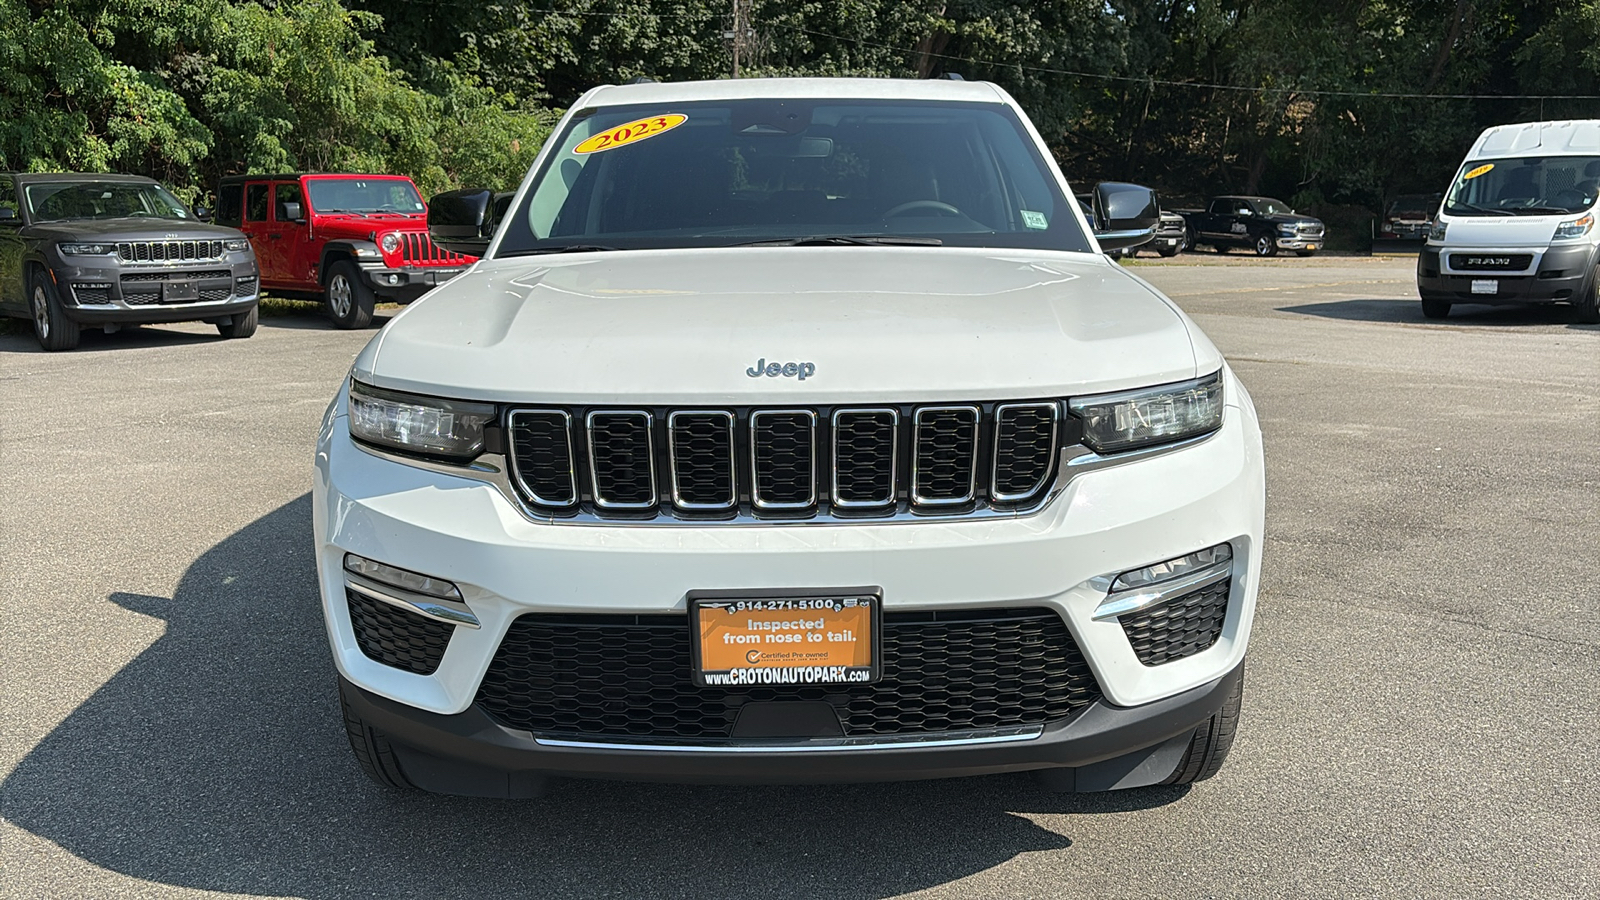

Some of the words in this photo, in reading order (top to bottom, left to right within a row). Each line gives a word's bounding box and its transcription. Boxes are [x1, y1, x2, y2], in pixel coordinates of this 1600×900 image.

[595, 118, 668, 150] 2023
[746, 358, 816, 381] Jeep
[736, 599, 834, 612] 914-271-5100
[747, 618, 824, 632] Inspected
[723, 632, 761, 644] from
[765, 633, 803, 643] nose
[806, 631, 823, 643] to
[827, 630, 857, 642] tail.
